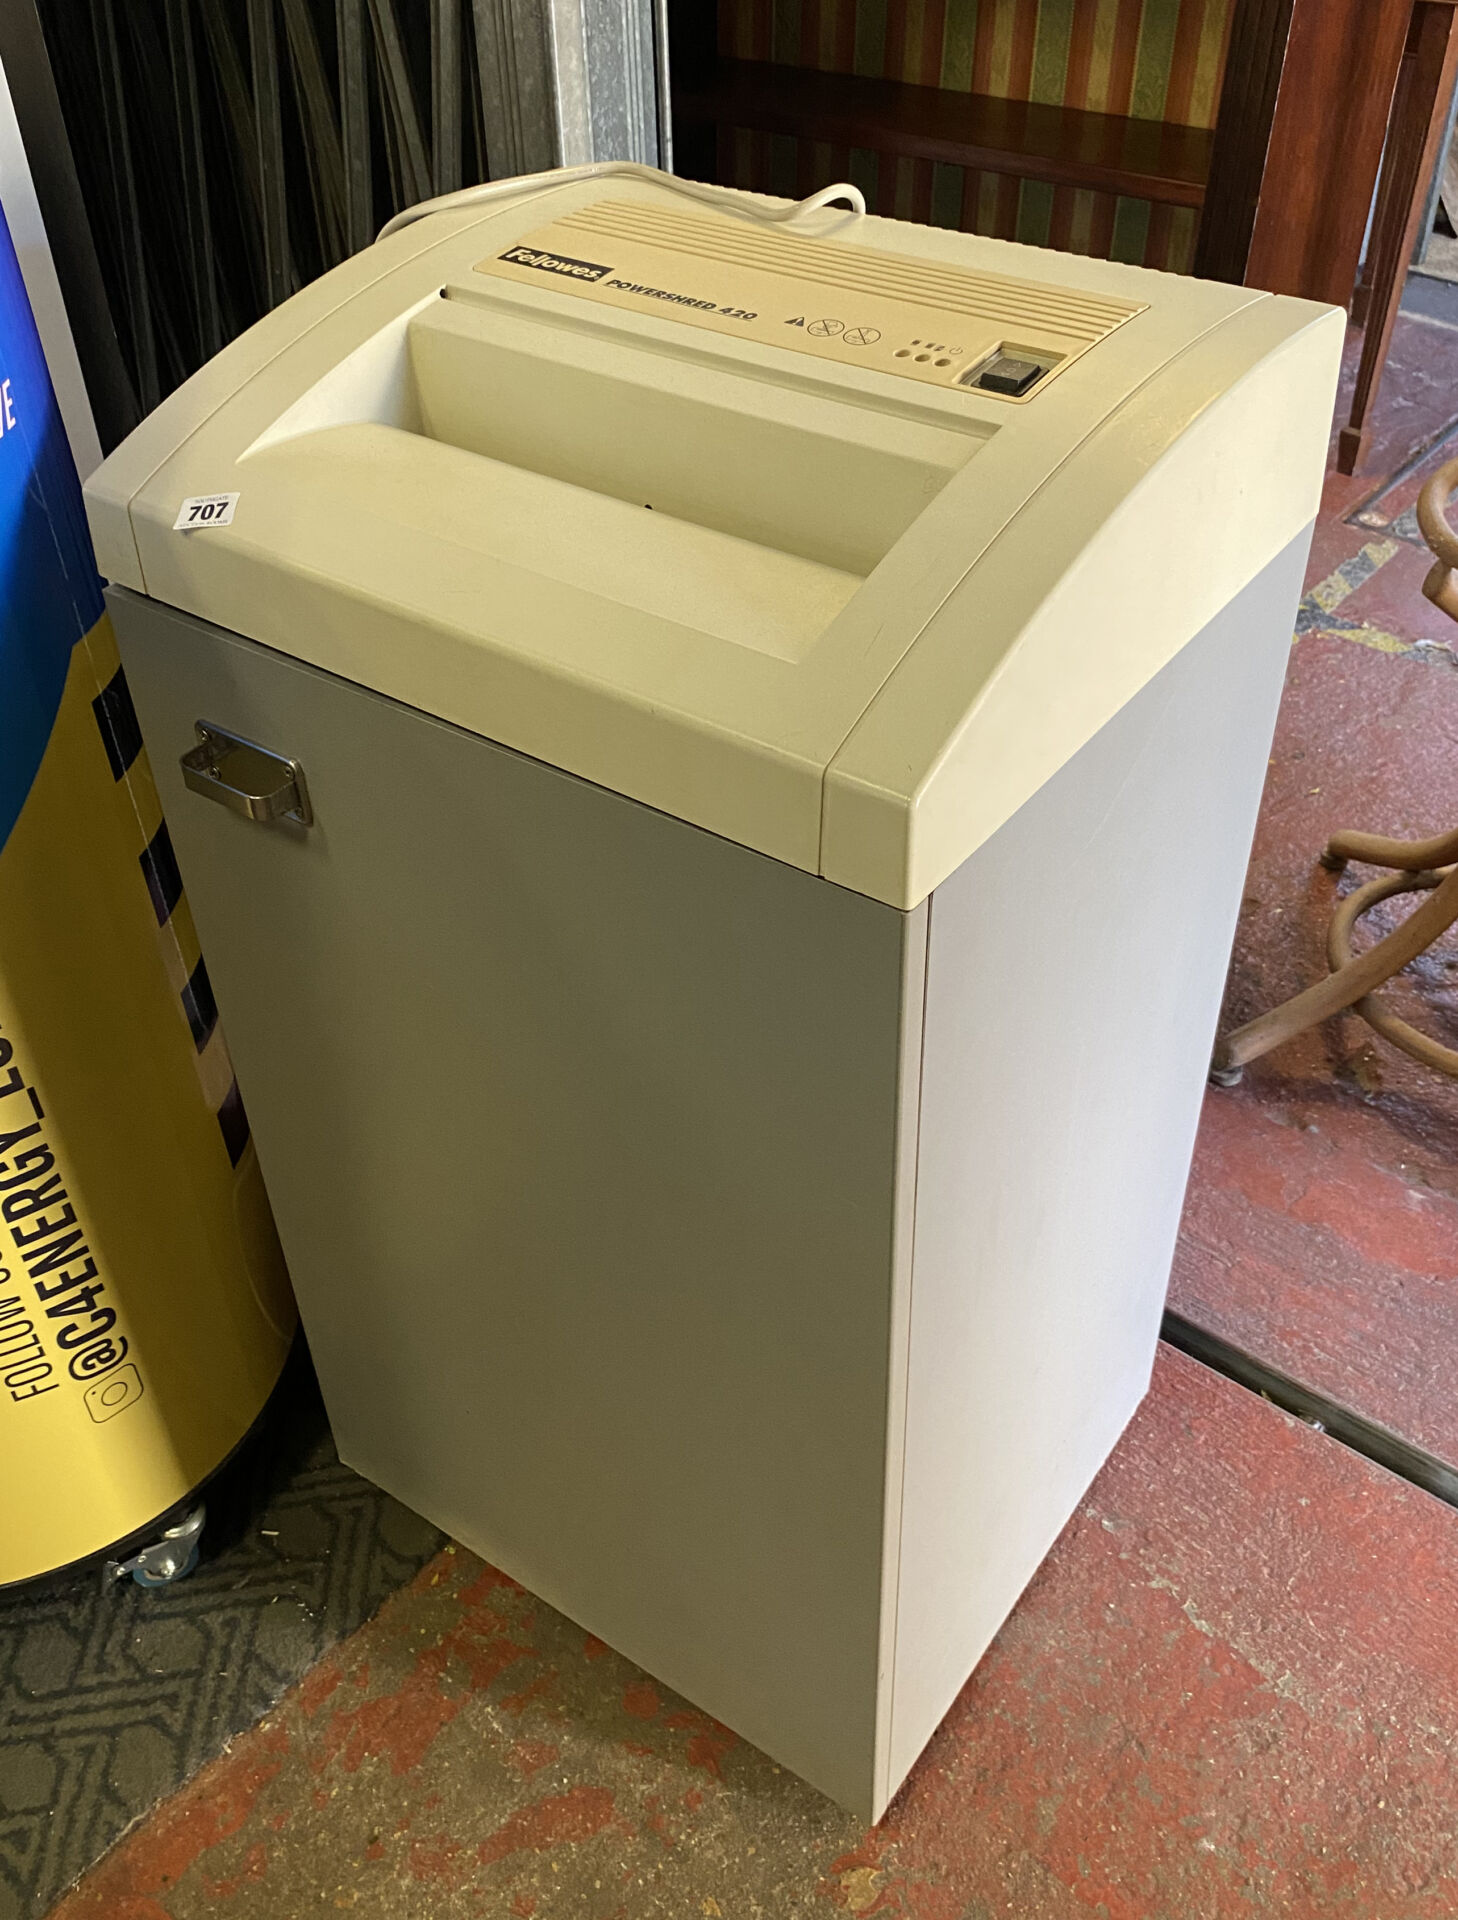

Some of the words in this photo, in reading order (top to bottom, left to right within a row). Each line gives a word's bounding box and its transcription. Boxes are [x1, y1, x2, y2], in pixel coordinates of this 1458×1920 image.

[505, 247, 601, 281] Fellowes
[606, 278, 717, 311] POWERSHRED
[719, 306, 758, 321] 420
[187, 501, 230, 522] 707
